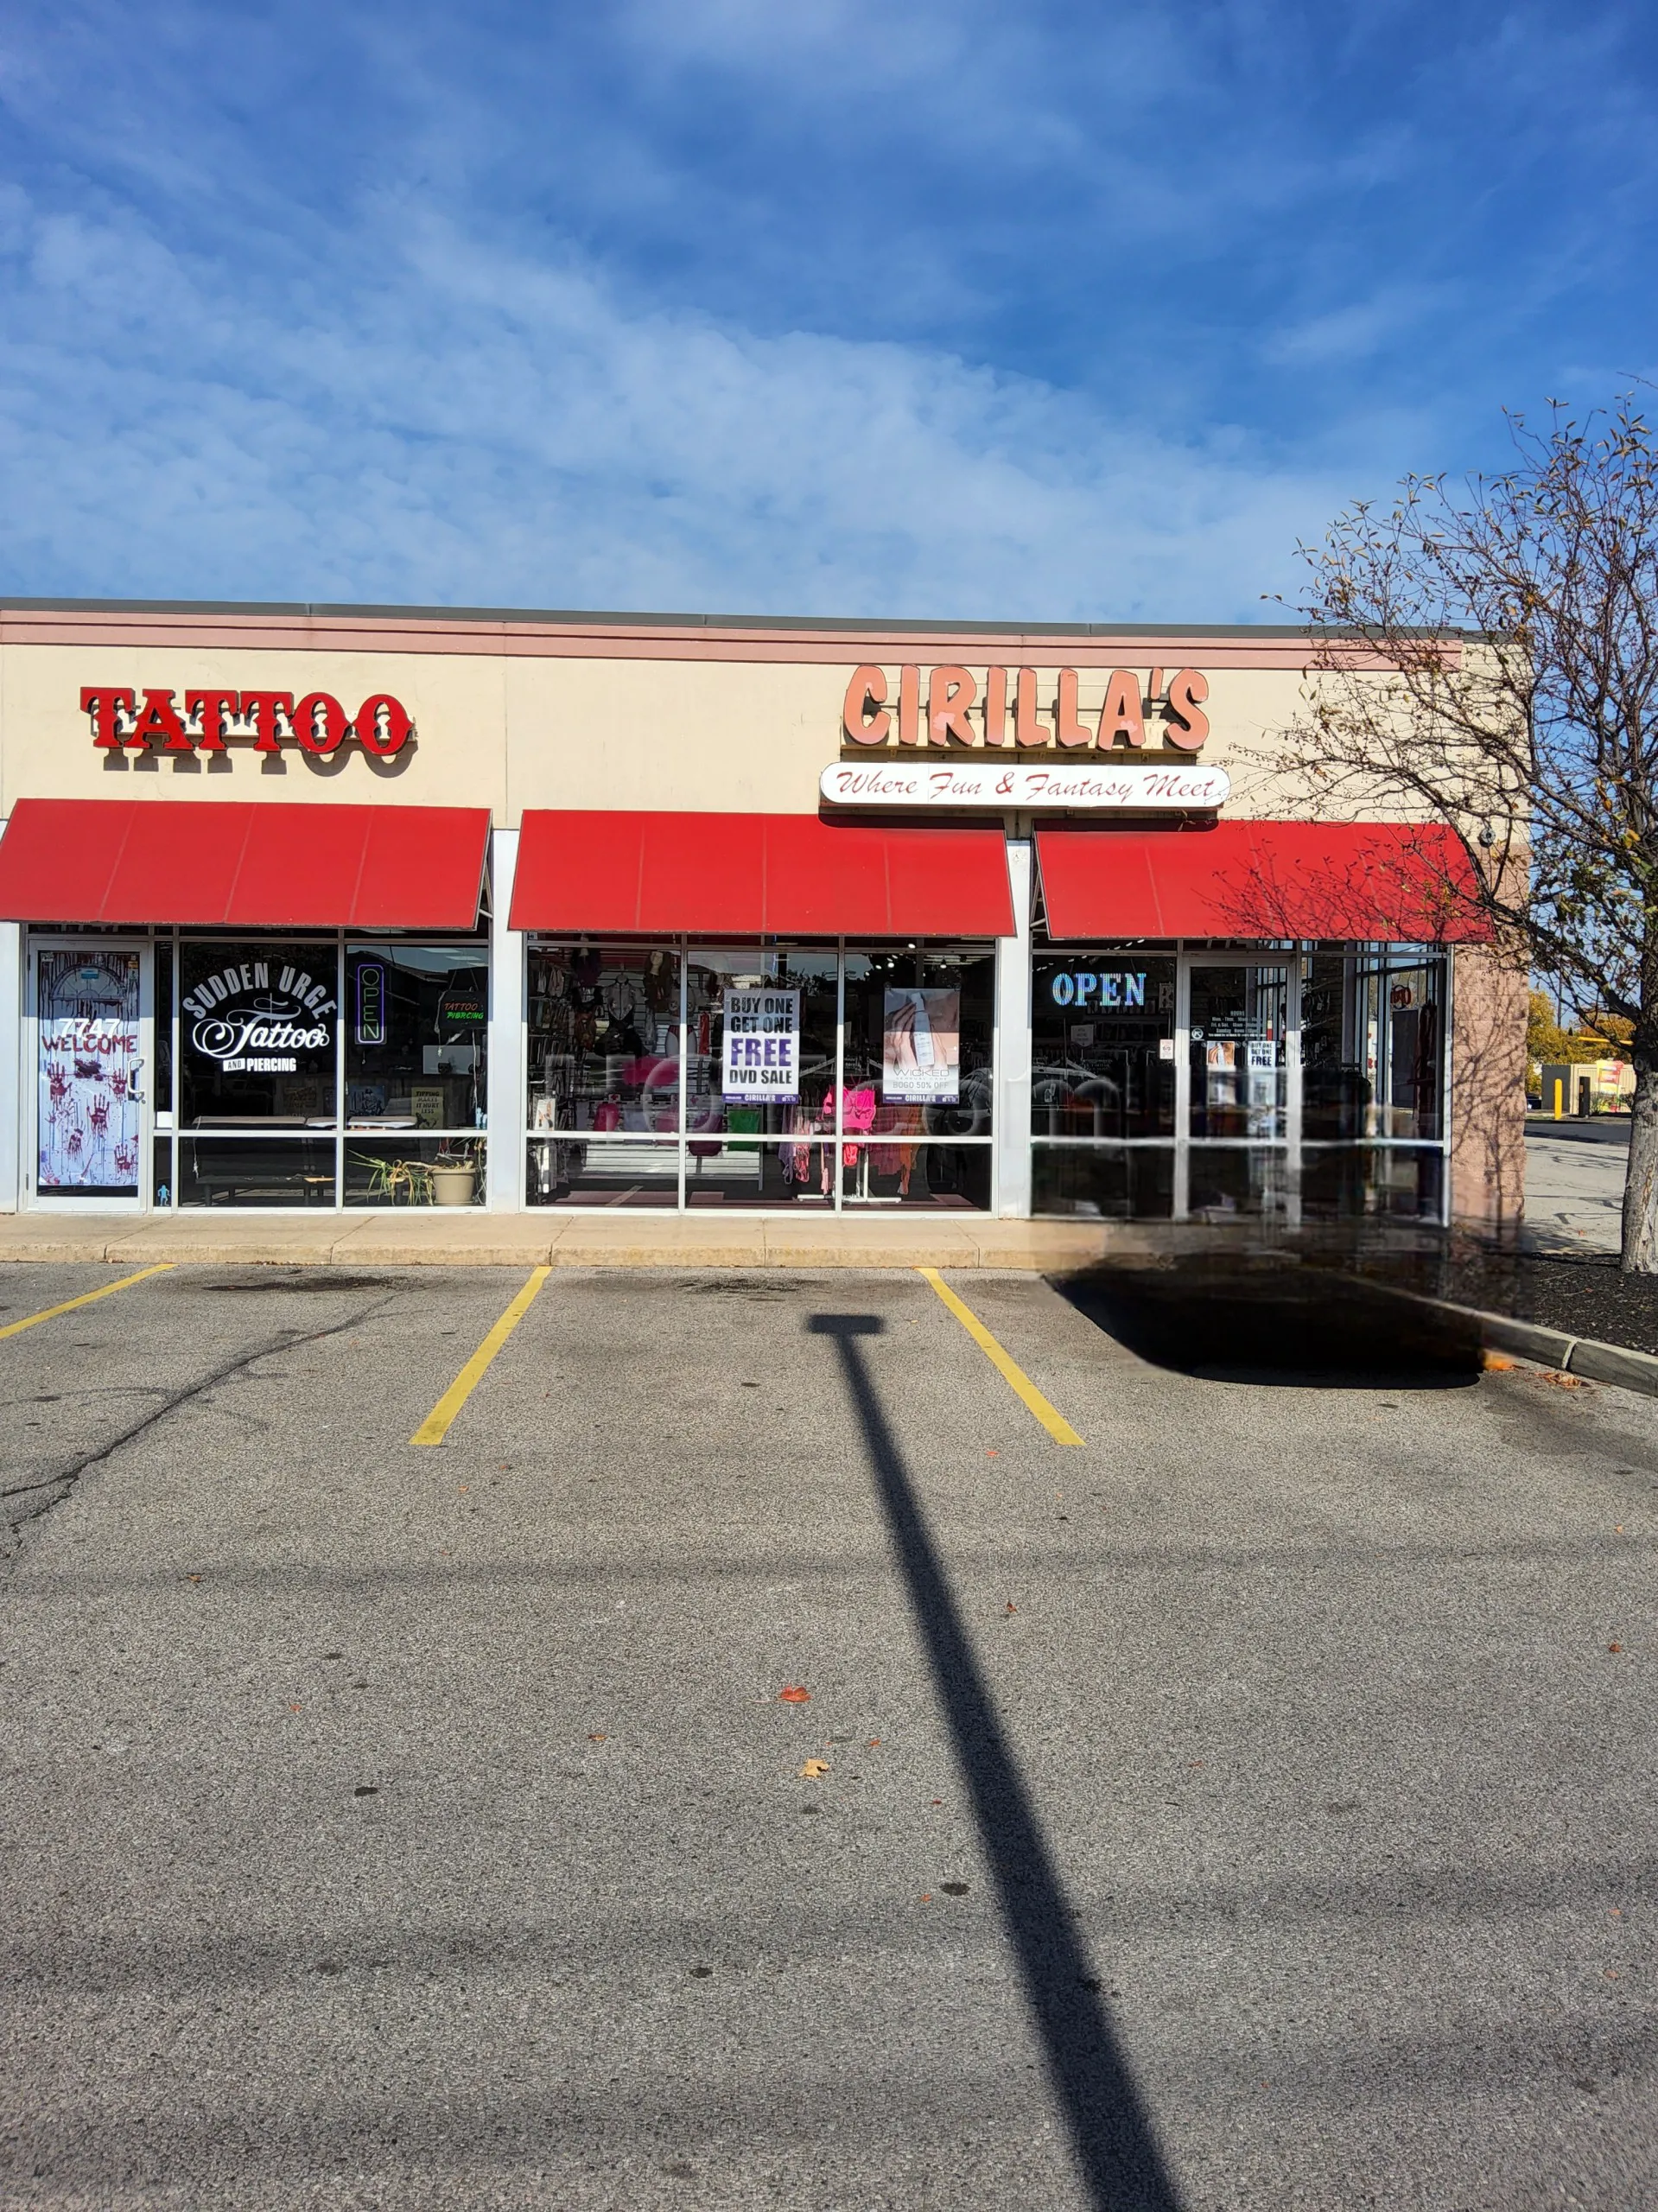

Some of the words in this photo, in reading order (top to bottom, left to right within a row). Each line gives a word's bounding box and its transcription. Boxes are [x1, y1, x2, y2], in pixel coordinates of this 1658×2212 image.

[843, 664, 1209, 751] CIRILLA'S
[80, 687, 415, 755] TATTOO
[836, 771, 918, 795] Where
[929, 772, 982, 799] Fun
[995, 772, 1015, 793] &
[1026, 773, 1135, 802] Fantasy
[1142, 773, 1216, 798] Meet
[182, 962, 269, 1020] SUDDEN
[278, 965, 338, 1020] URGE
[1052, 973, 1147, 1006] OPEN
[362, 968, 379, 1040] OPEN
[444, 1002, 479, 1011] TATTOO
[731, 997, 761, 1014] BUY
[765, 997, 793, 1014] ONE
[59, 1018, 121, 1039] 7747
[193, 997, 330, 1058] Tattoo
[731, 1016, 759, 1033] GET
[763, 1017, 793, 1034] ONE
[41, 1033, 138, 1054] WELCOME
[731, 1038, 791, 1067] FREE
[226, 1058, 243, 1071] AND
[246, 1058, 297, 1072] PIERCING
[1251, 1056, 1272, 1066] FREE
[730, 1070, 757, 1084] DVD
[761, 1070, 792, 1084] SALE
[893, 1069, 950, 1077] WICKED
[905, 1094, 937, 1103] CIRILLA'S
